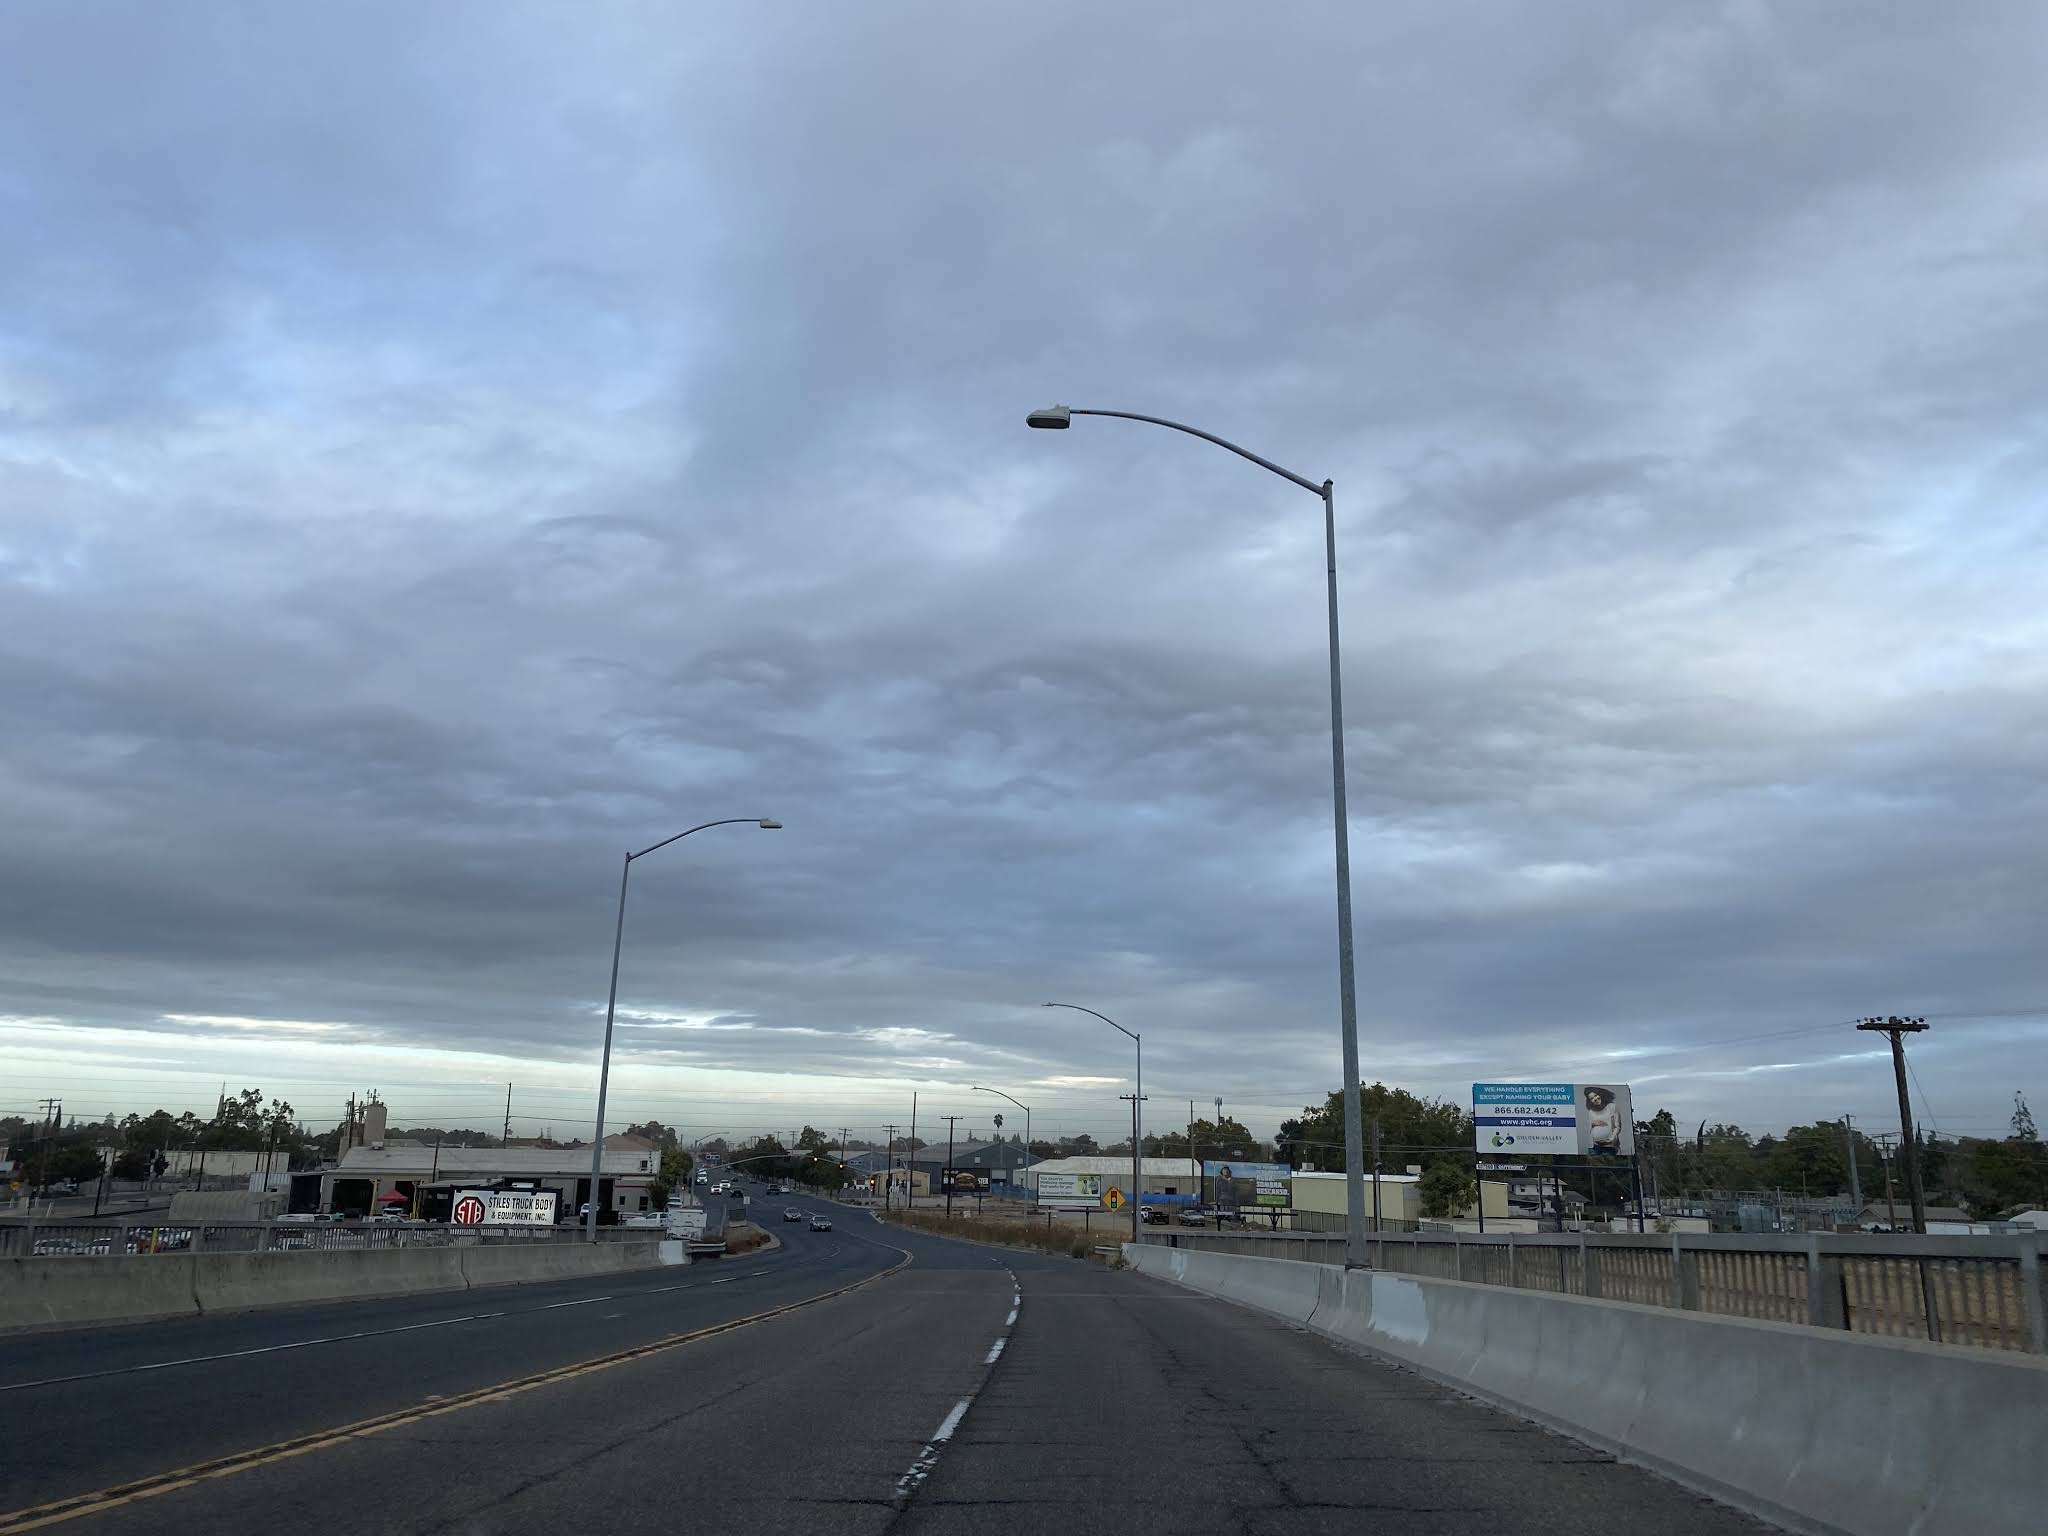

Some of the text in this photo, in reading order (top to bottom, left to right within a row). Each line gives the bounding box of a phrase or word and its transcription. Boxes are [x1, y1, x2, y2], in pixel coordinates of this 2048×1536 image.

[488, 1197, 554, 1210] STILES TRUCK BODY
[498, 1212, 533, 1222] EQUIPMENT,
[535, 1213, 547, 1221] INC.
